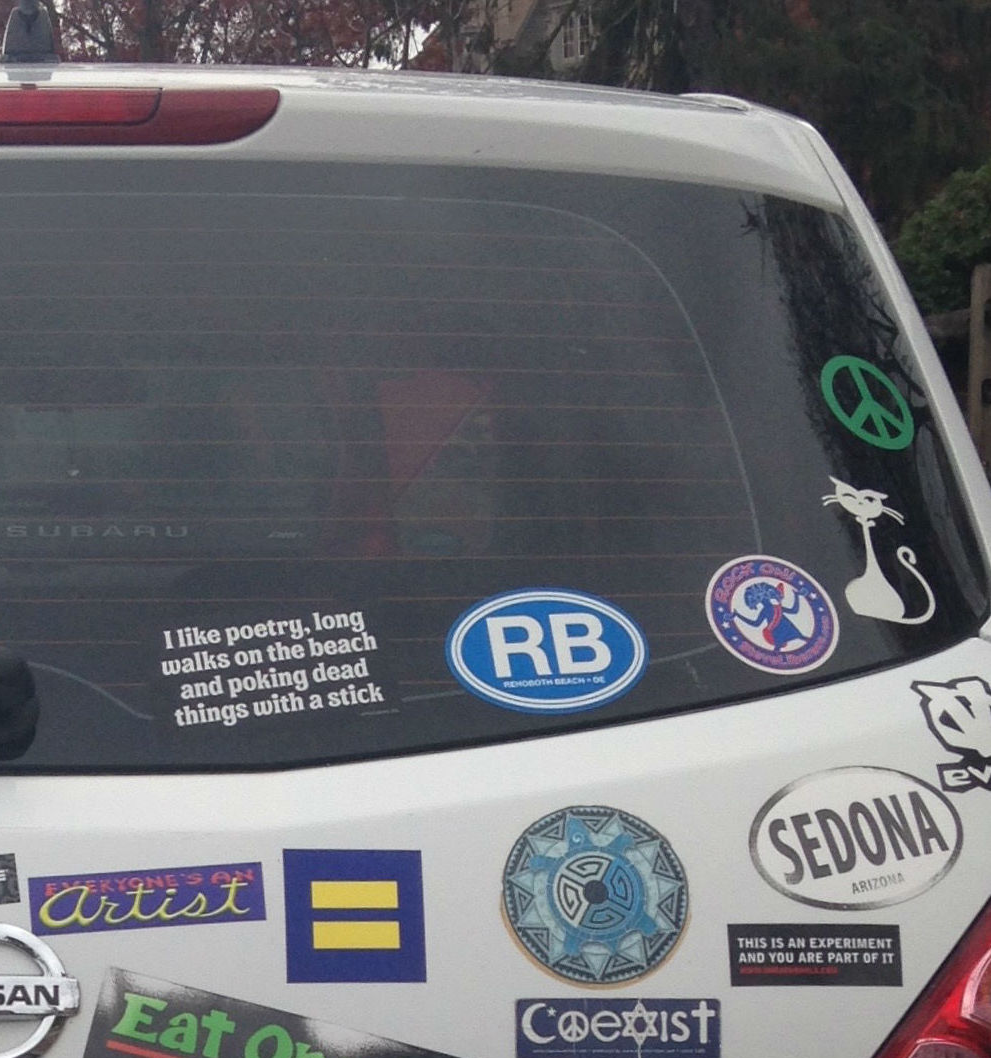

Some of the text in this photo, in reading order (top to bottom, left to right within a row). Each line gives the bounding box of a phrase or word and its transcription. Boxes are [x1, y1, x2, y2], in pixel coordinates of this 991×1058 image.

[6, 525, 189, 538] SUBARU
[163, 610, 365, 649] I like poetry, long
[486, 612, 612, 678] RB
[161, 632, 378, 676] walks on the beach
[180, 658, 369, 700] and poking dead
[503, 676, 606, 689] REHOBOTH BEACH DE
[174, 683, 385, 727] things with a stick
[768, 790, 949, 886] SEDONA
[44, 868, 255, 897] EVERYONE'S AN
[851, 872, 905, 895] ARIZONA
[737, 937, 892, 949] THIS IS AN EXPERIMENT
[738, 952, 894, 964] AND YOU ARE PART OF IT
